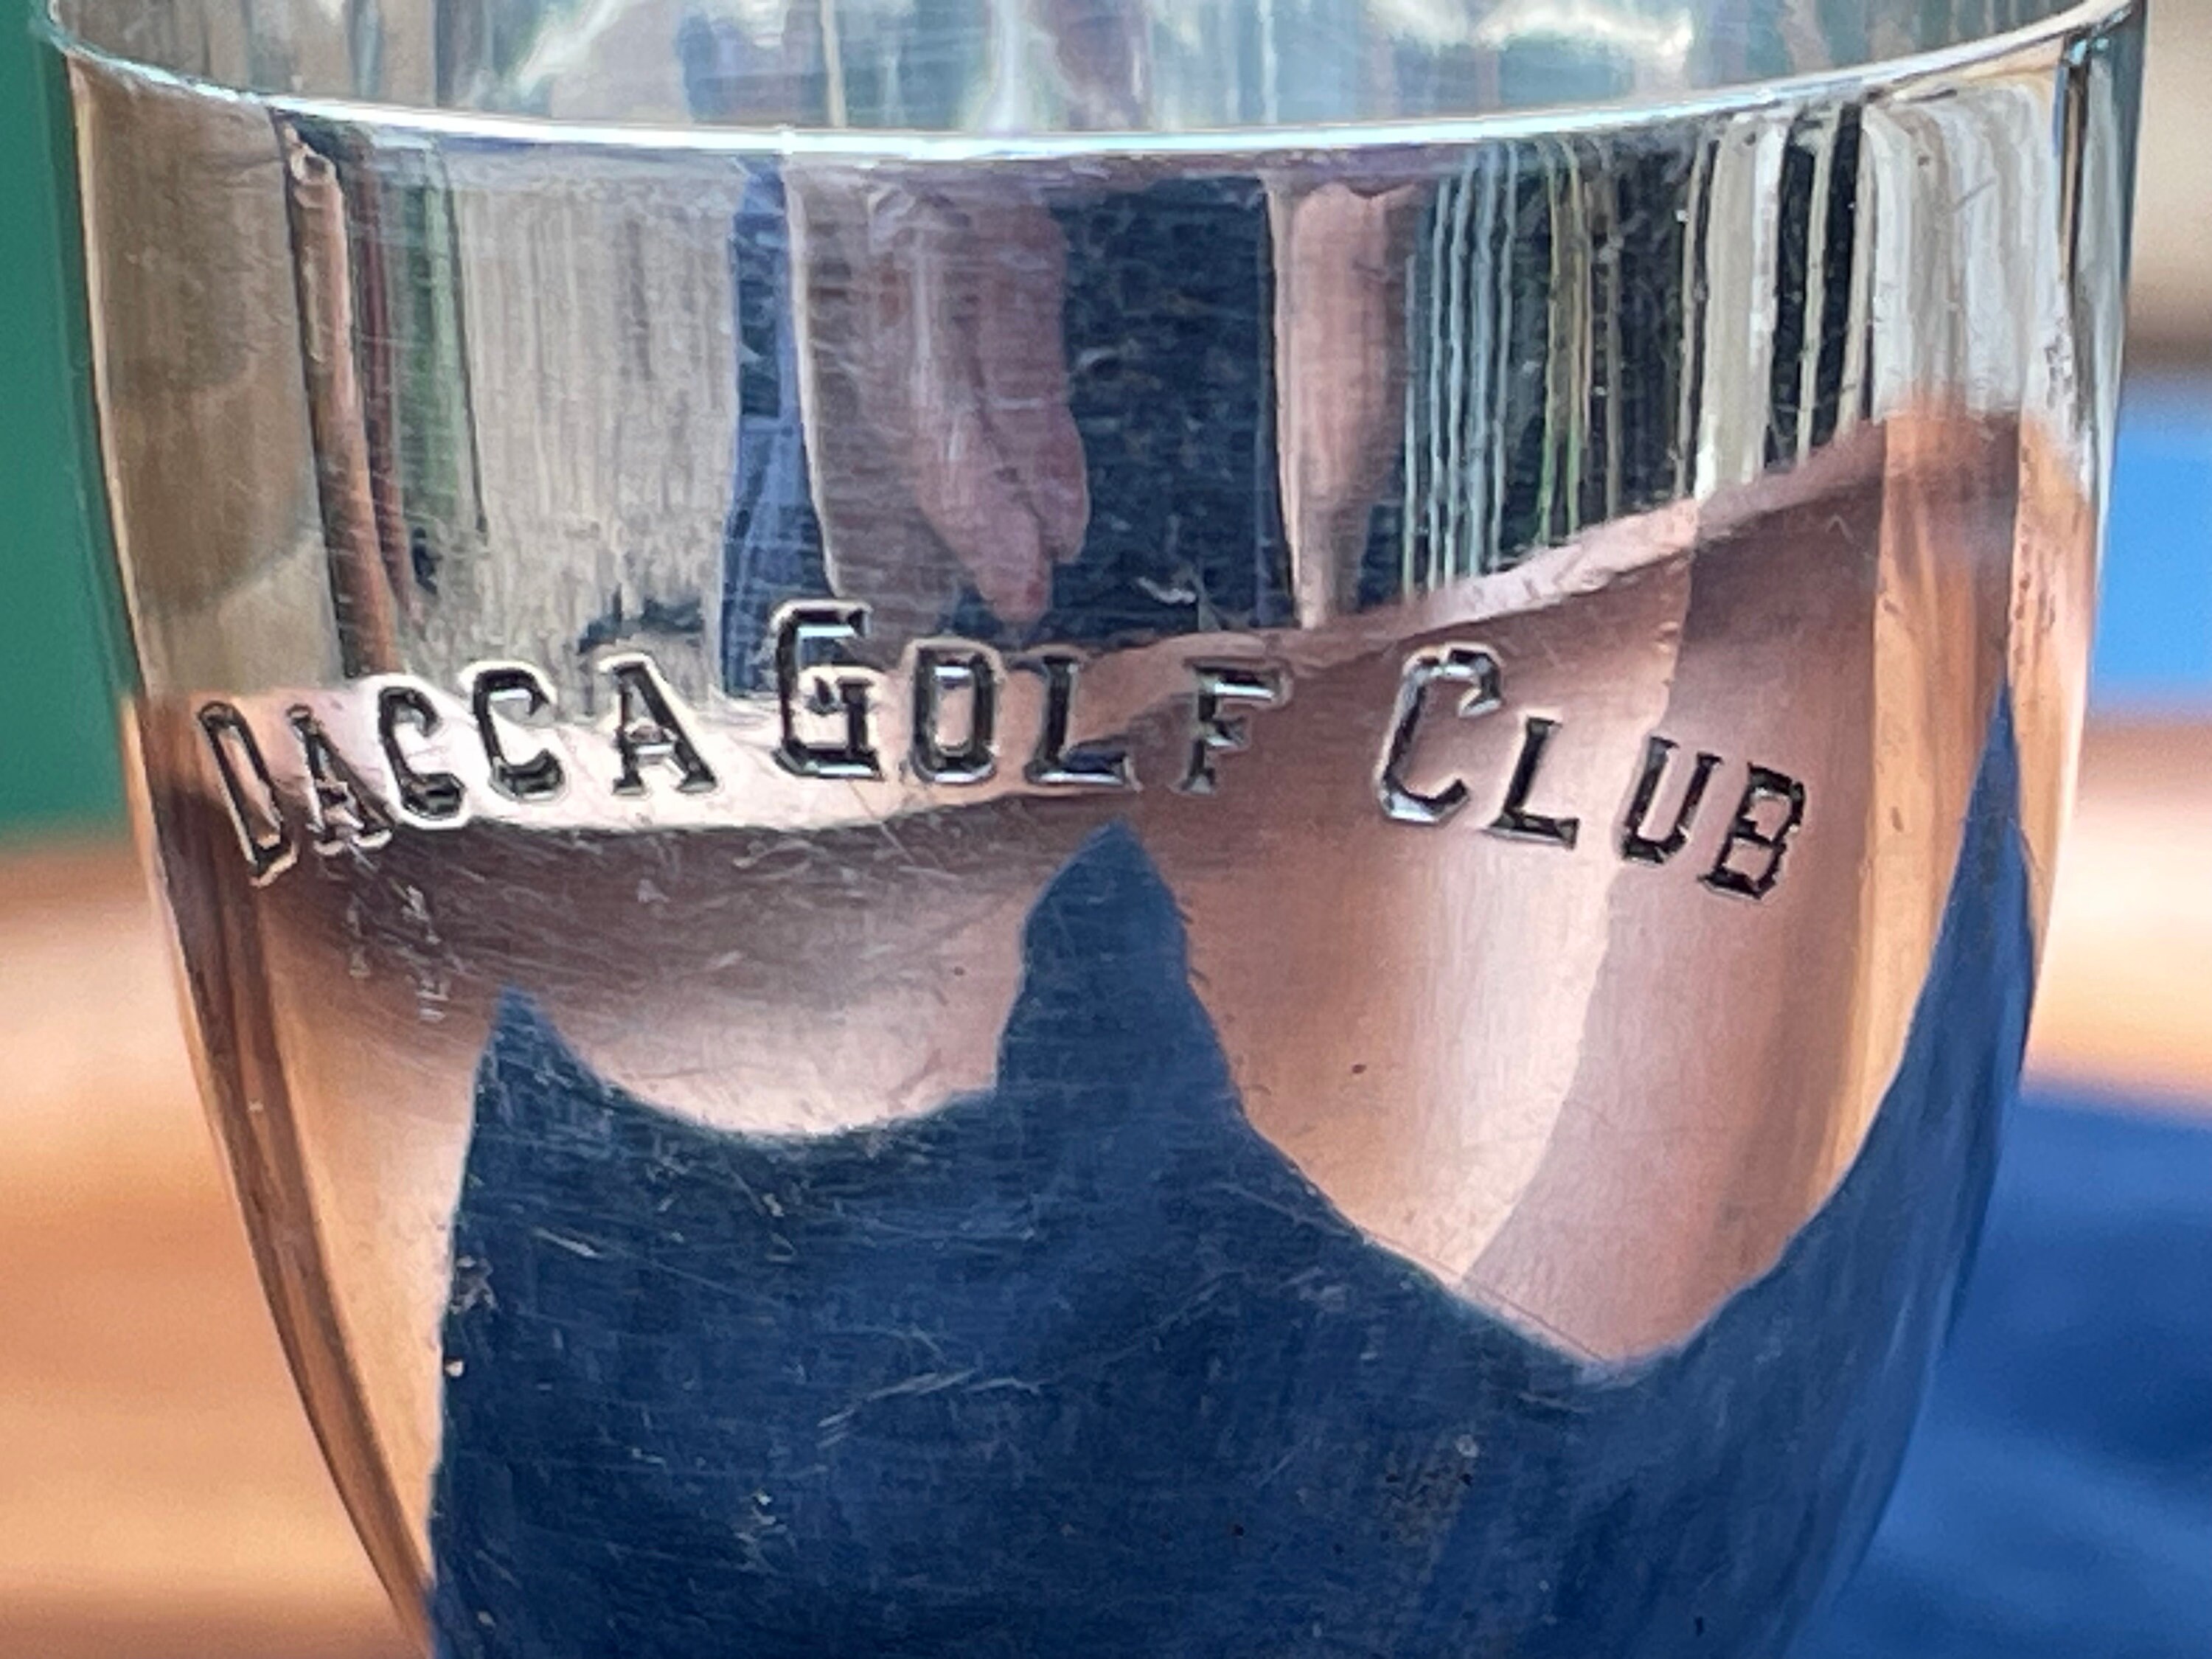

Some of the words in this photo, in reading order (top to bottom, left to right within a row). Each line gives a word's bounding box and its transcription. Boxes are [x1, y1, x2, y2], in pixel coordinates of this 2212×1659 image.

[198, 653, 719, 886] DACCA
[773, 600, 1292, 795] GOLF
[1374, 643, 1806, 901] CLUB
